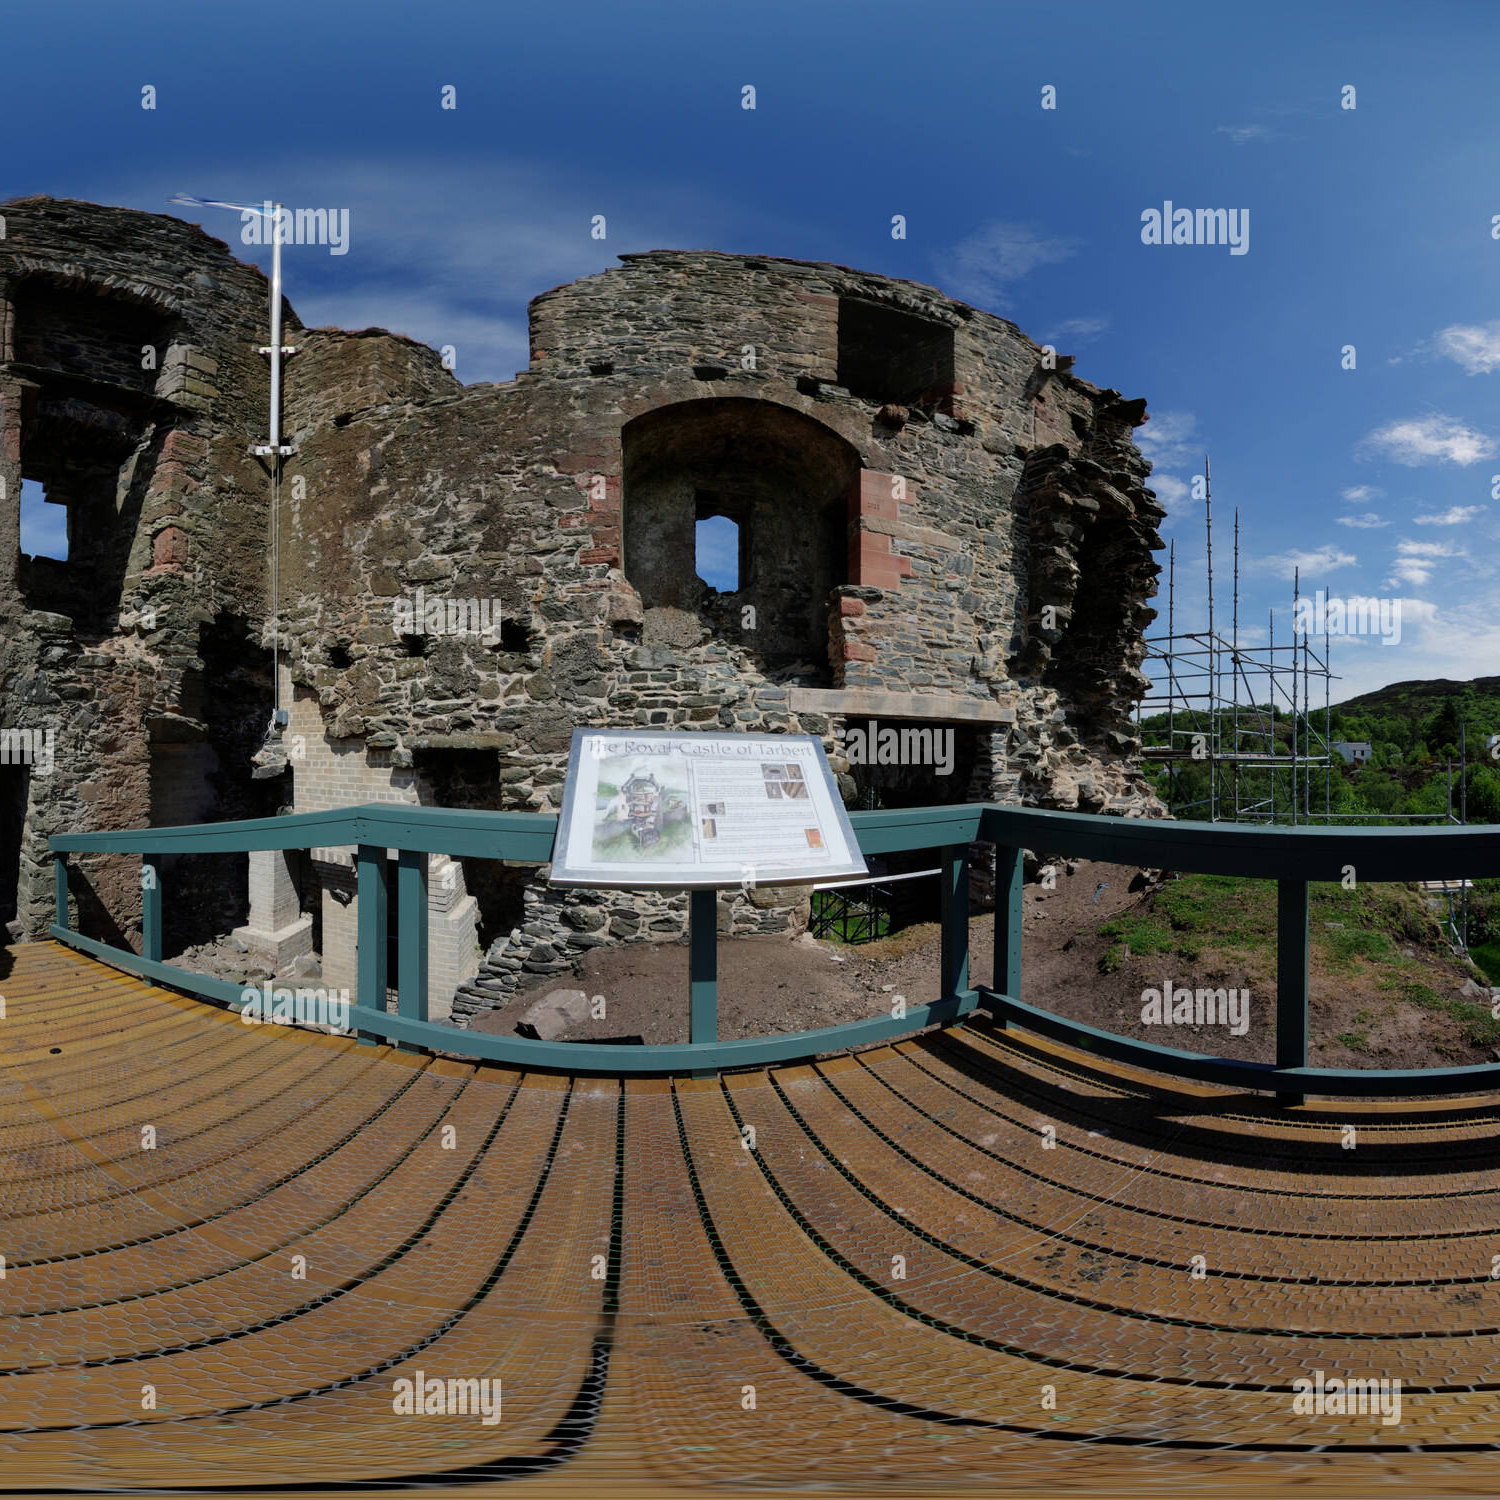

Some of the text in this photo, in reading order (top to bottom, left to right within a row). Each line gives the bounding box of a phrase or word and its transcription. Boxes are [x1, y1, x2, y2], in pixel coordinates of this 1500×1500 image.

[625, 740, 673, 757] Royal
[679, 741, 732, 755] Castle
[737, 742, 754, 756] of
[757, 743, 812, 757] Tarbert
